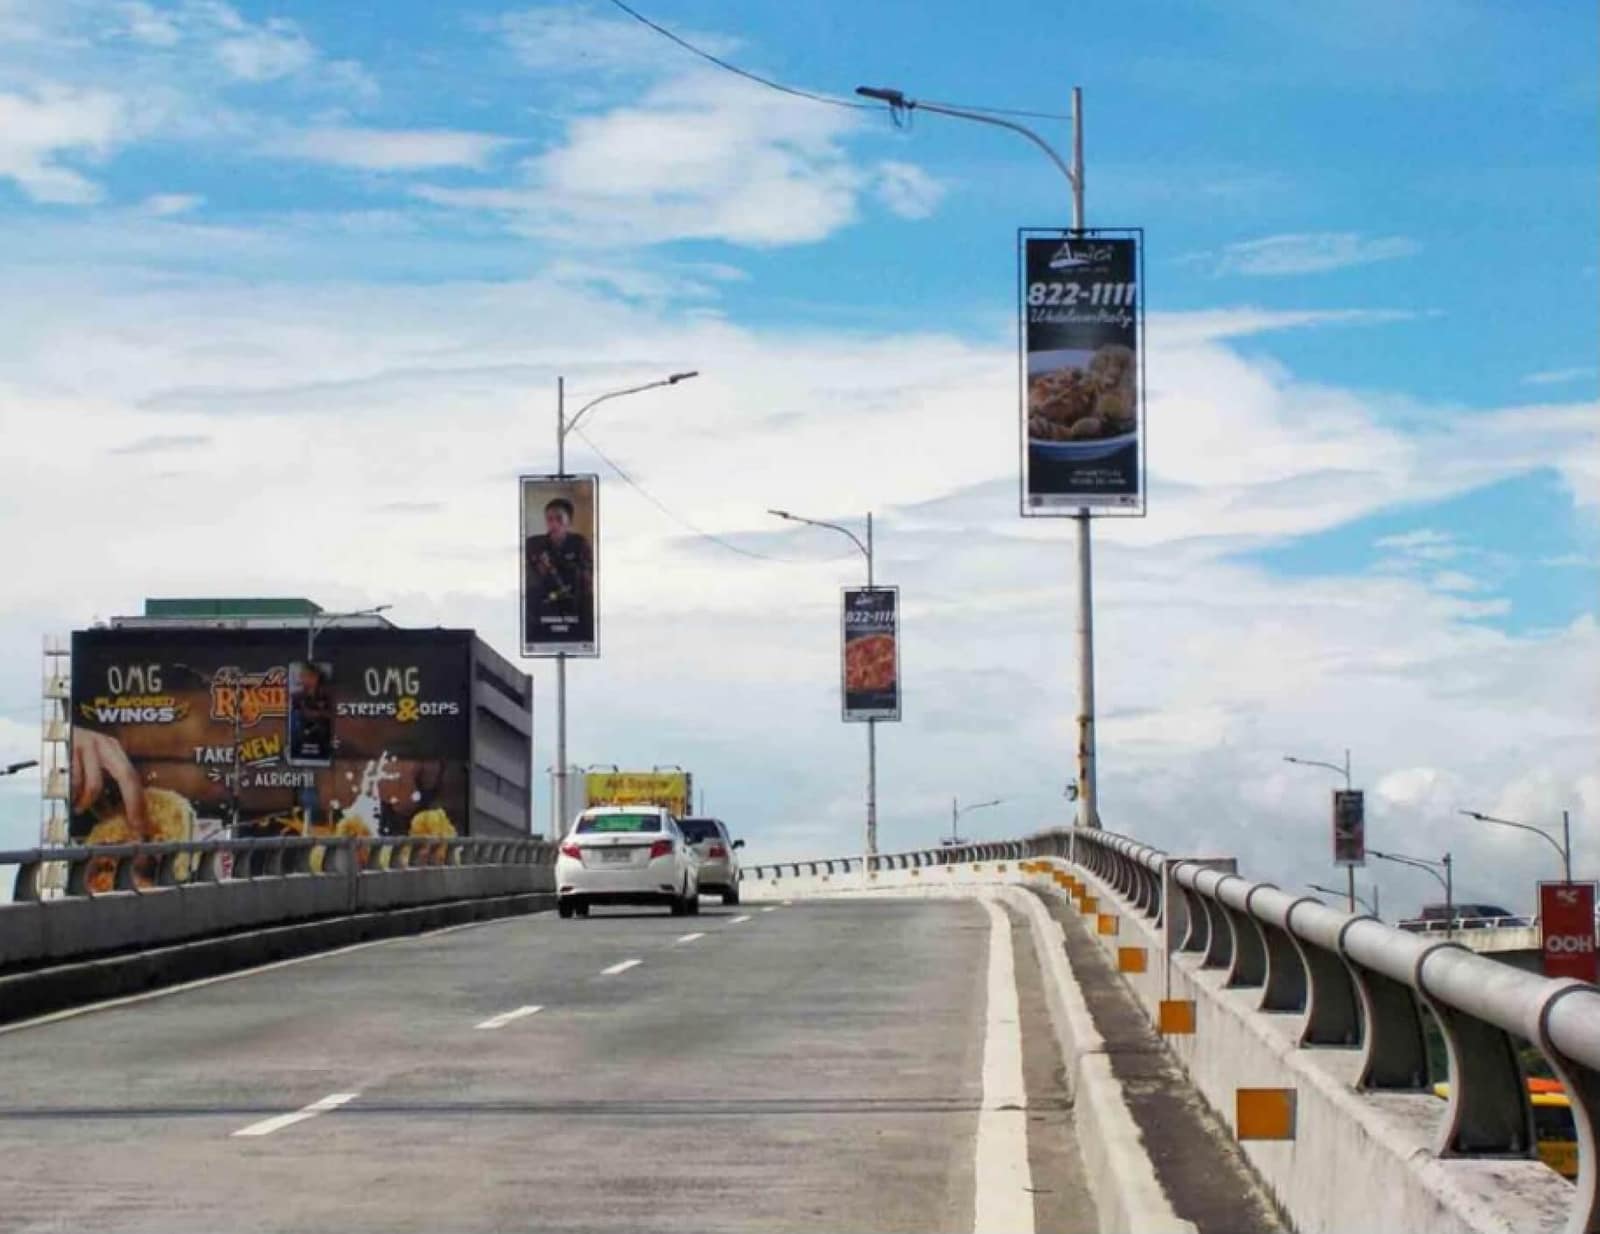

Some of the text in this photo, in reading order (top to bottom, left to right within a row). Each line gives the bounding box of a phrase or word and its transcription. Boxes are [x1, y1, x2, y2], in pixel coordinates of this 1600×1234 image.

[1028, 282, 1136, 306] 822-1111
[107, 664, 162, 694] OMG
[364, 666, 421, 696] OMG
[96, 707, 175, 723] WINGS
[336, 702, 396, 715] STRIPS
[395, 697, 420, 722] &
[194, 746, 233, 764] TAKE
[239, 735, 281, 762] NEW
[1546, 935, 1594, 952] OOH
